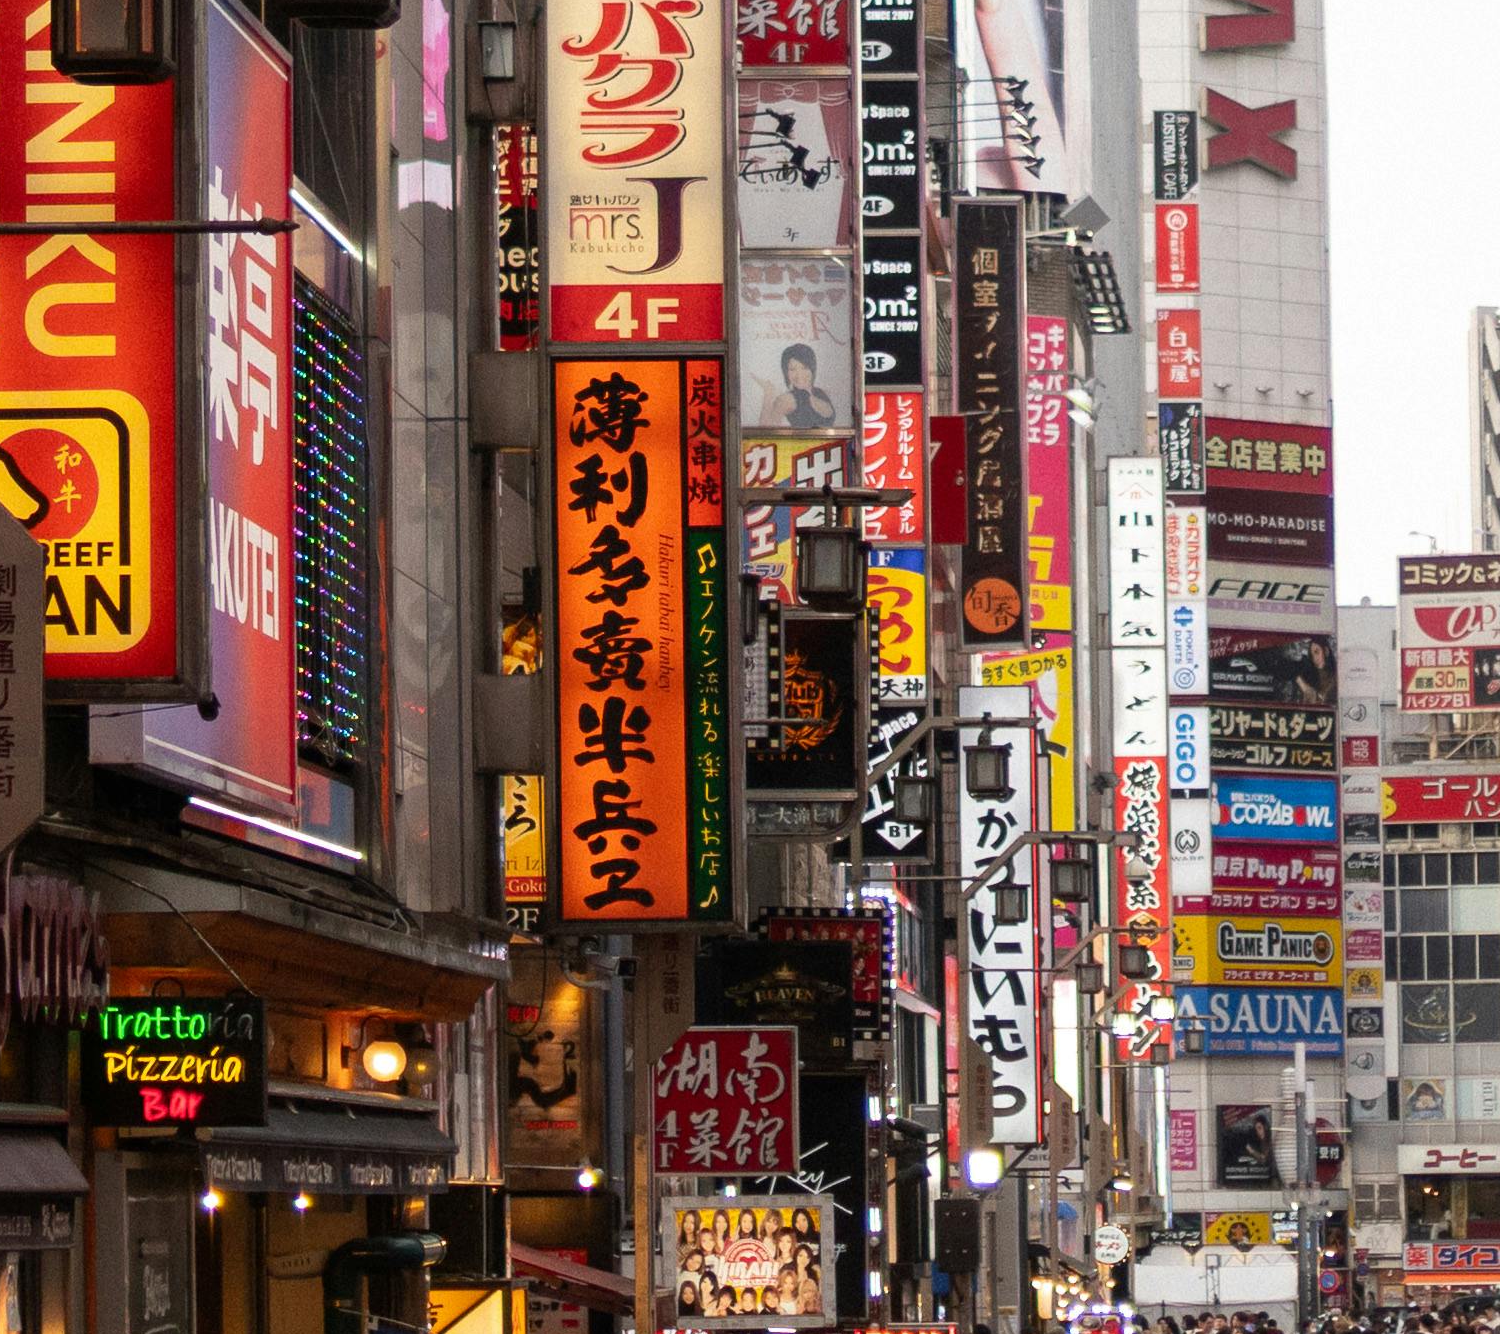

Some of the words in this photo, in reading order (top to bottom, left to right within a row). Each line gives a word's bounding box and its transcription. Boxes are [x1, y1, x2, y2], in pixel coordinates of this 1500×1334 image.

[770, 42, 809, 64] 4F
[861, 44, 882, 58] 5F
[868, 105, 909, 119] Space
[1164, 171, 1177, 198] CAFE
[863, 200, 881, 214] 4F
[570, 208, 644, 240] mrs.
[605, 177, 708, 276] J
[782, 228, 799, 241] 3F
[570, 241, 645, 254] Kabukicho
[870, 260, 911, 275] Space
[594, 292, 681, 339] 4F
[866, 355, 885, 371] 3F
[688, 374, 721, 507] 炭火串焼
[1206, 436, 1326, 475] 全店営業中
[53, 444, 82, 514] 和牛
[1207, 513, 1326, 532] MO-MO-PARADISE
[1208, 579, 1329, 603] FACE
[981, 653, 1067, 682] 今すぐ見つかる
[1405, 649, 1469, 667] 新宿最大
[880, 678, 923, 698] 天神
[1406, 694, 1470, 708] ハイジアB1
[1176, 714, 1196, 783] GiGO
[1246, 745, 1287, 766] ゴルフ
[889, 826, 911, 837] B1
[1213, 856, 1244, 877] 東京
[1247, 859, 1287, 885] Ping
[1212, 894, 1253, 908] カラオケ
[1307, 896, 1337, 909] ダーツ
[1220, 923, 1263, 956] GAME
[1267, 925, 1312, 958] PANIC
[1210, 993, 1342, 1034] SAUNA
[832, 1036, 847, 1049] B1
[107, 1048, 243, 1085] Pizzeria
[657, 1033, 785, 1104] 湖南
[140, 1088, 205, 1122] Bar
[657, 1110, 681, 1168] 4F
[686, 1108, 784, 1169] 菜館
[1425, 1149, 1496, 1168] コーヒー
[1406, 1243, 1429, 1267] 薬
